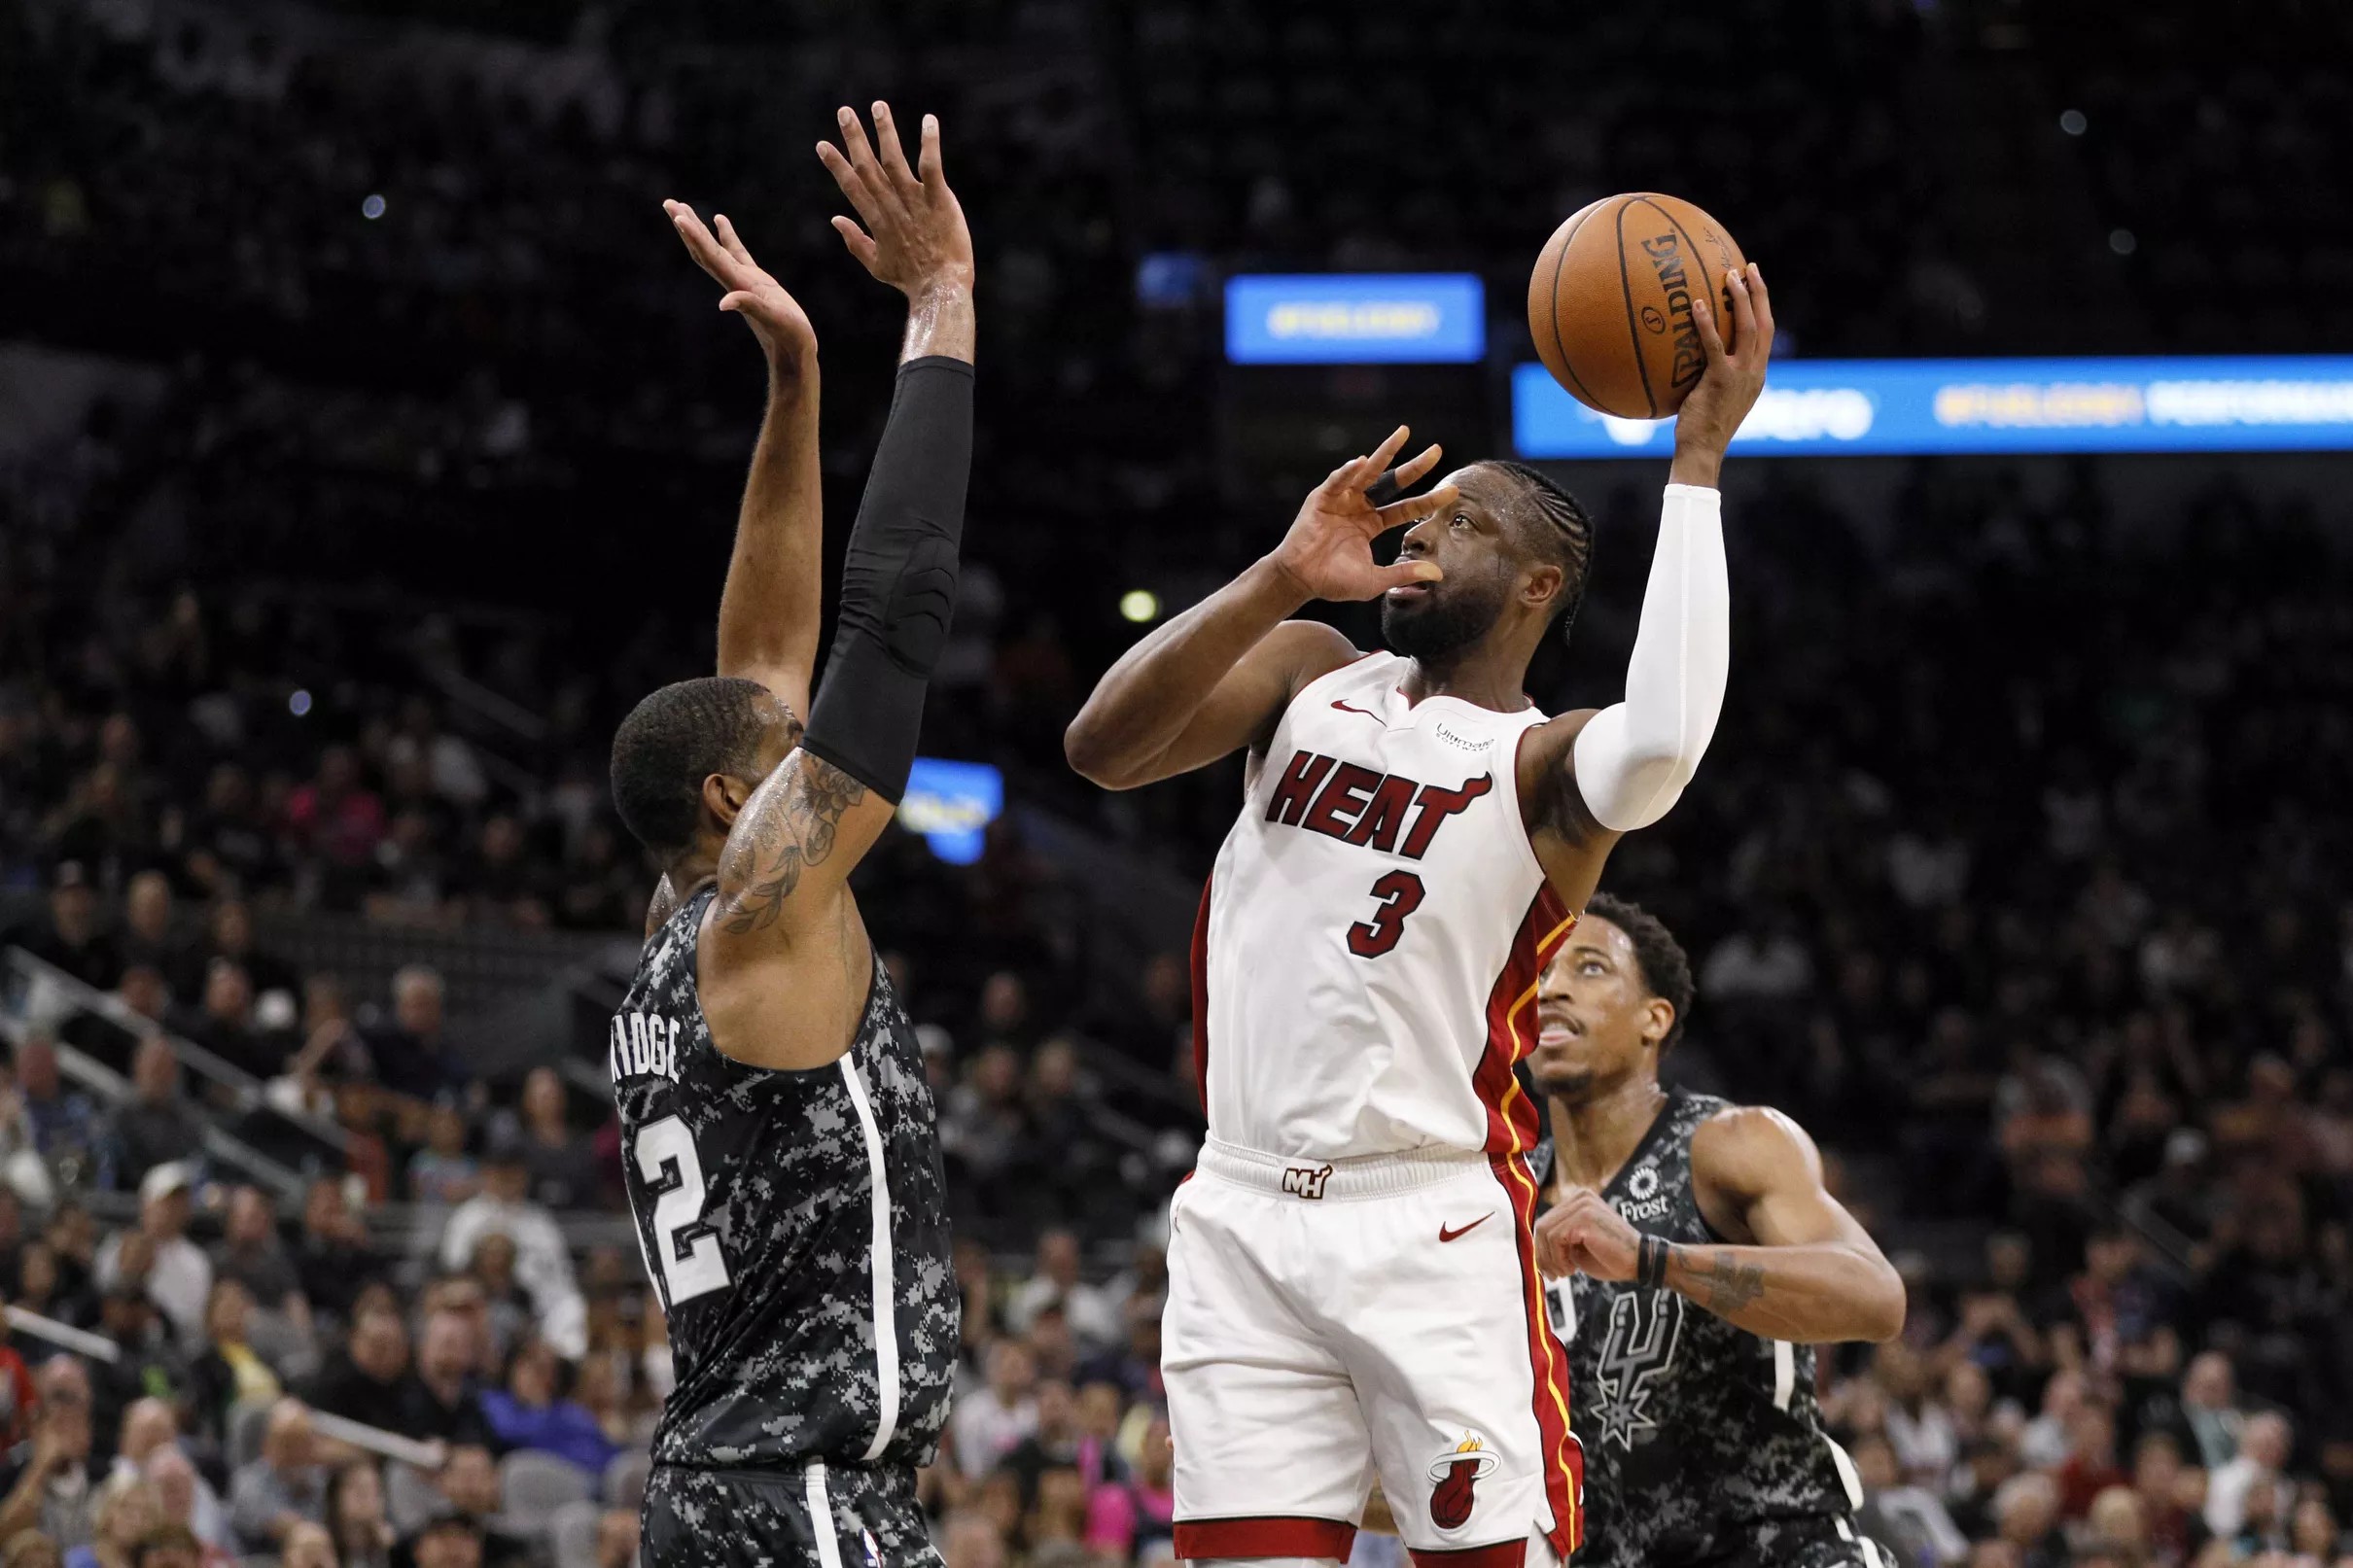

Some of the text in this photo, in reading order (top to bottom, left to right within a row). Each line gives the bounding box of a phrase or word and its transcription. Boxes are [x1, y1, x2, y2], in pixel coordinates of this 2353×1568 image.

[1265, 749, 1493, 861] HEAT
[1346, 868, 1426, 960] 3
[628, 1113, 733, 1313] 2
[1620, 1194, 1669, 1222] Frost
